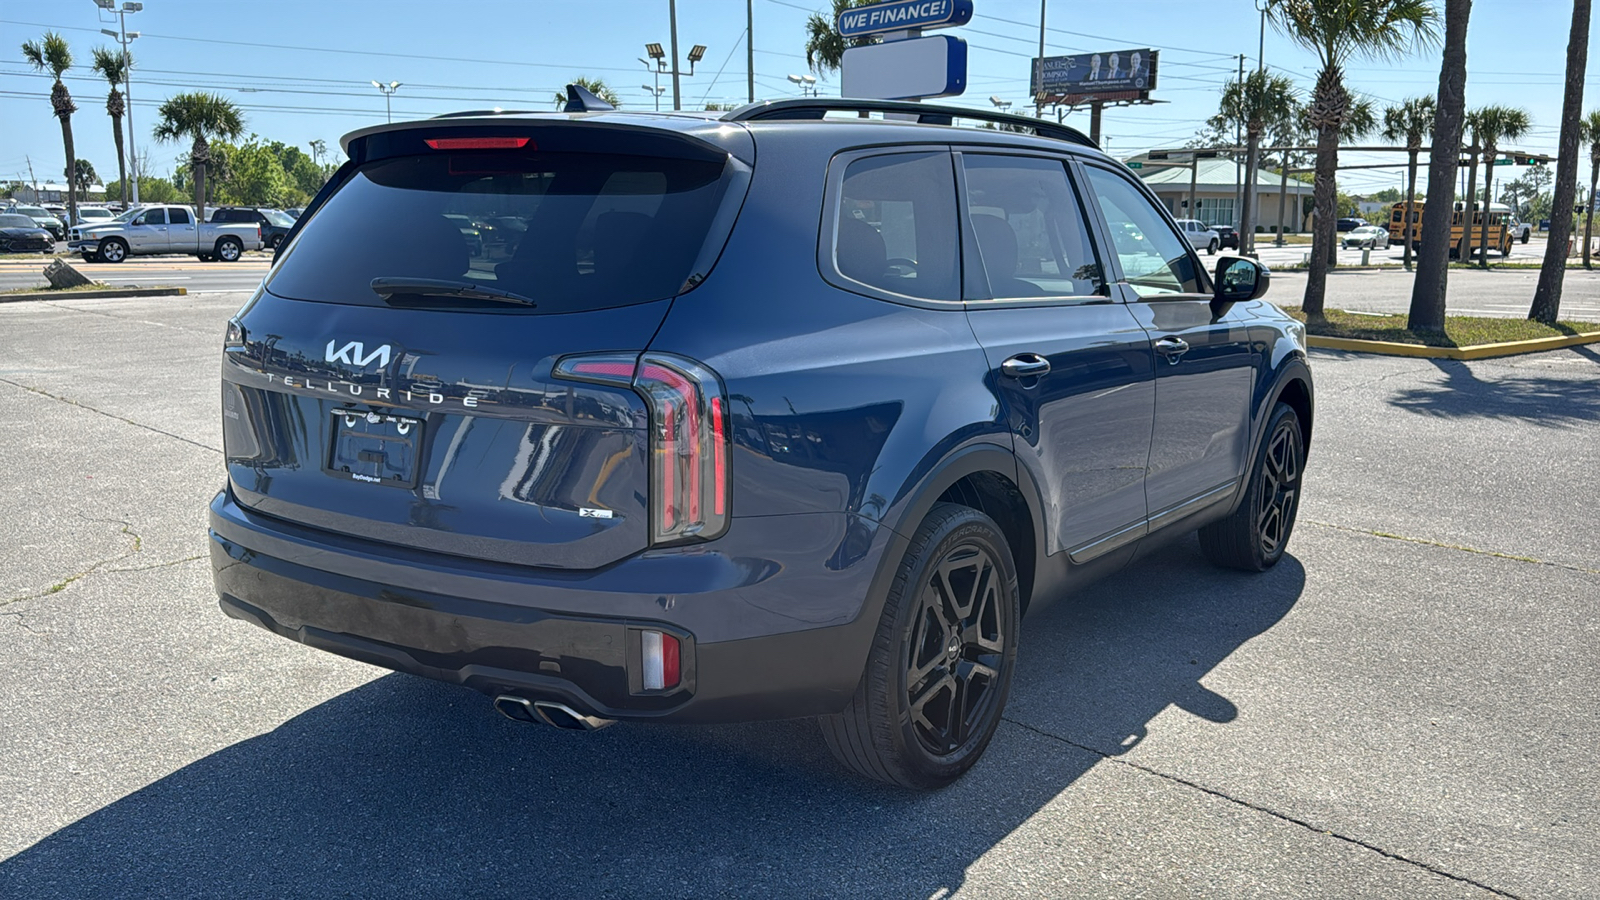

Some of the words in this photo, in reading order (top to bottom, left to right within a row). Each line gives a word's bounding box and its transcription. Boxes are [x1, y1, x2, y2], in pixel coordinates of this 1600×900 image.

[843, 13, 868, 30] WE
[869, 0, 947, 26] FINANCE!
[325, 339, 391, 368] KIA
[266, 372, 478, 407] TELLURIDE
